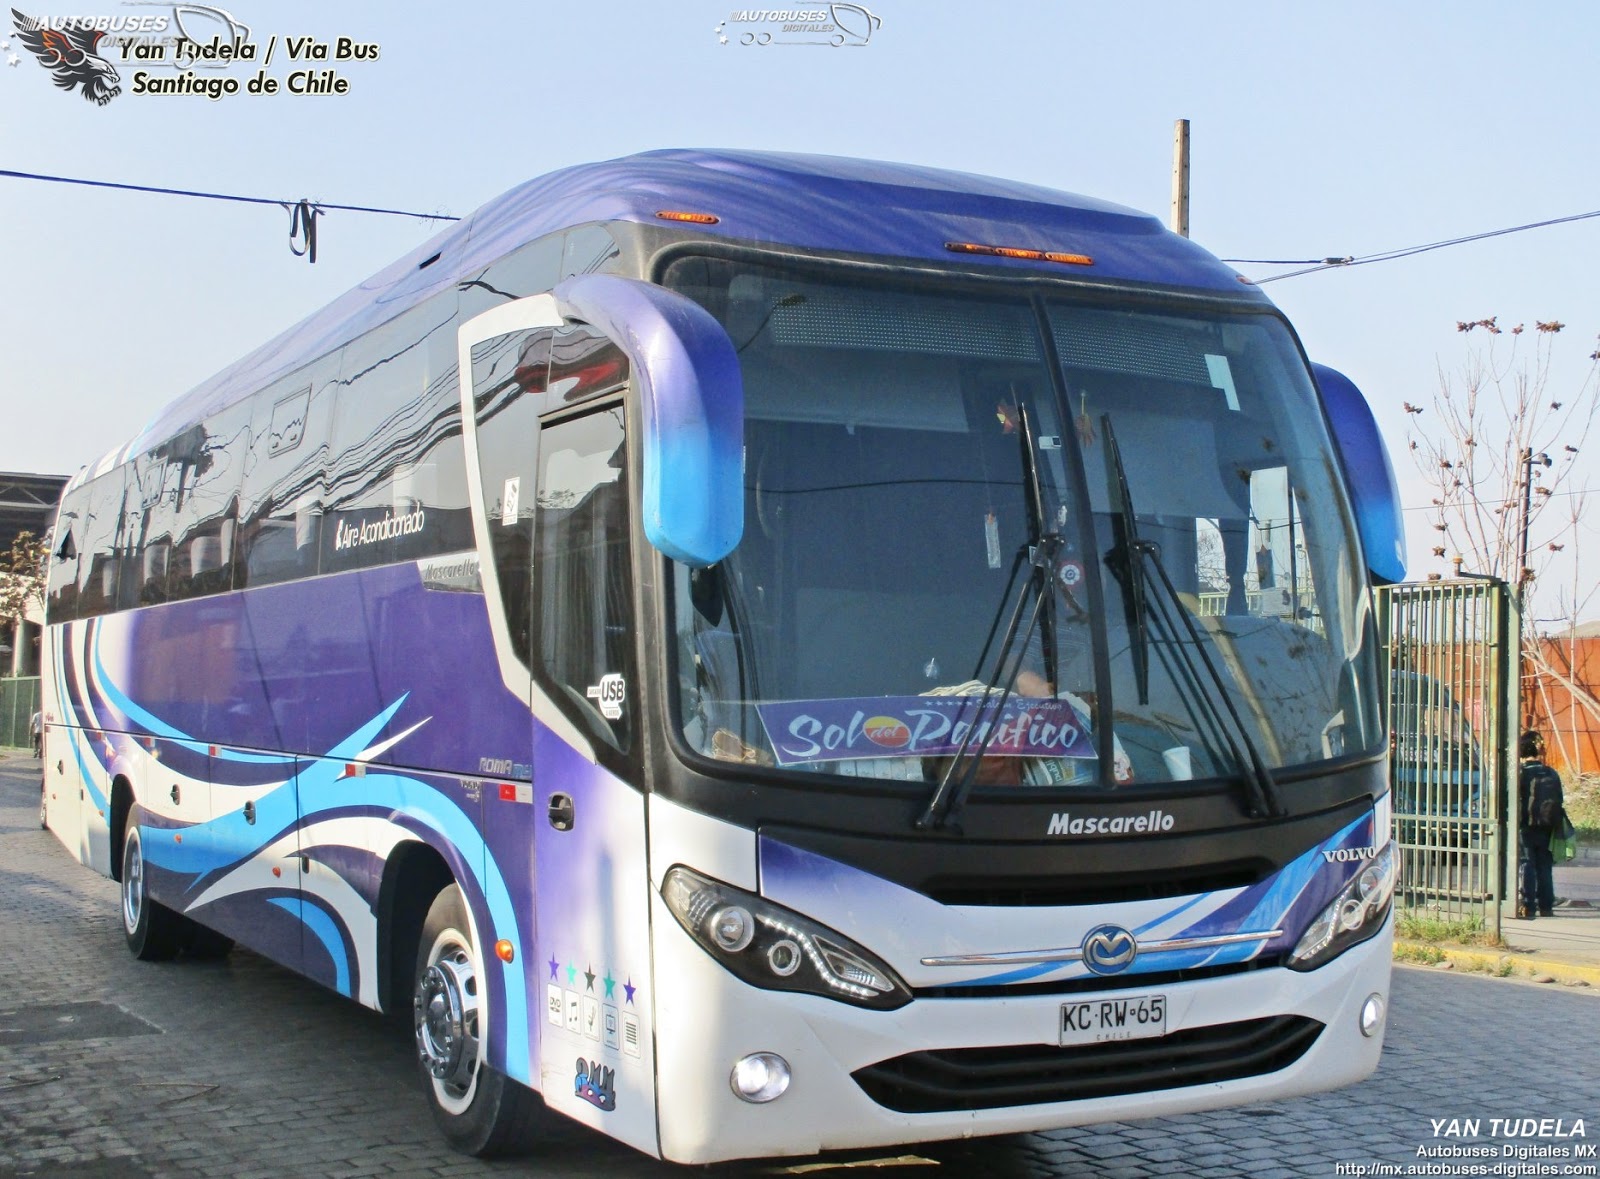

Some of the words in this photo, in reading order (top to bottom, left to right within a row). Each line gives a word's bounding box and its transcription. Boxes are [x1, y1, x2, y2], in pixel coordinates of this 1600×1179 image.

[358, 501, 425, 547] Acondicionado
[424, 558, 475, 581] Mascarello
[601, 680, 625, 702] USB
[781, 710, 865, 757] Sol
[870, 723, 899, 739] del
[479, 757, 512, 775] ROMA
[1046, 810, 1175, 835] Mascarello
[1322, 846, 1376, 863] VOLVO
